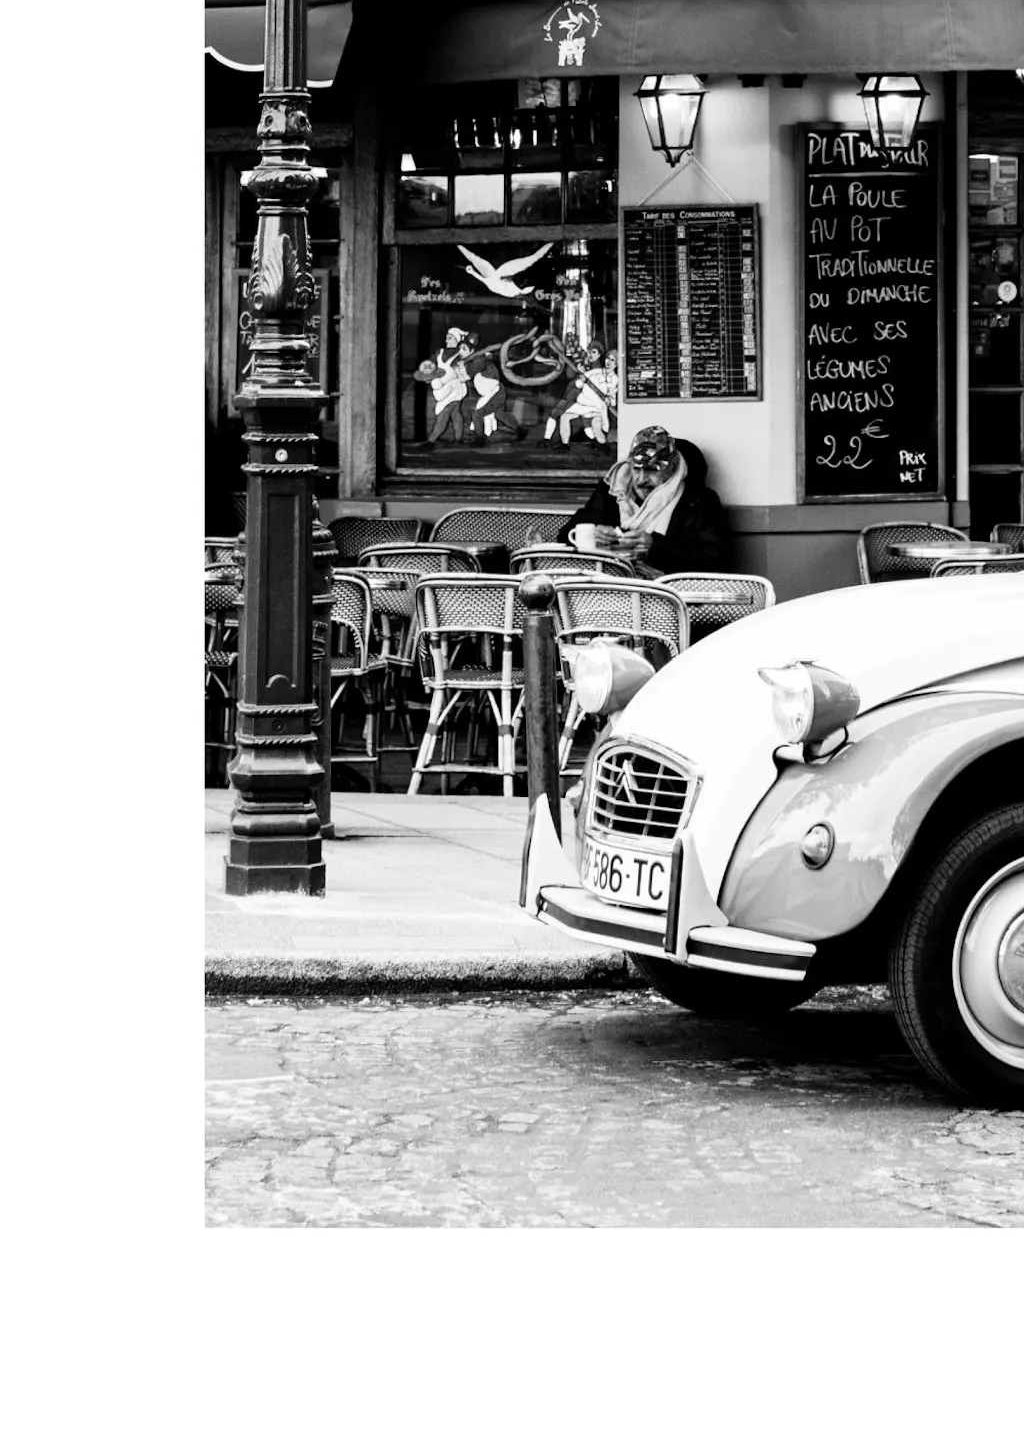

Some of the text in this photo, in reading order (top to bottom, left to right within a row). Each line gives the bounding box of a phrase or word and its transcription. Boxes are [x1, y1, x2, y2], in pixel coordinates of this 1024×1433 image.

[808, 132, 860, 166] PLAT
[809, 182, 907, 208] LA POULE
[810, 215, 891, 243] AU POT
[809, 285, 931, 308] DU DIMANCHE
[808, 321, 908, 345] AVEC SES
[807, 355, 890, 380] LÉGUMES
[810, 383, 894, 412] ANCIENS
[900, 450, 927, 465] PRIX
[900, 468, 926, 483] NET
